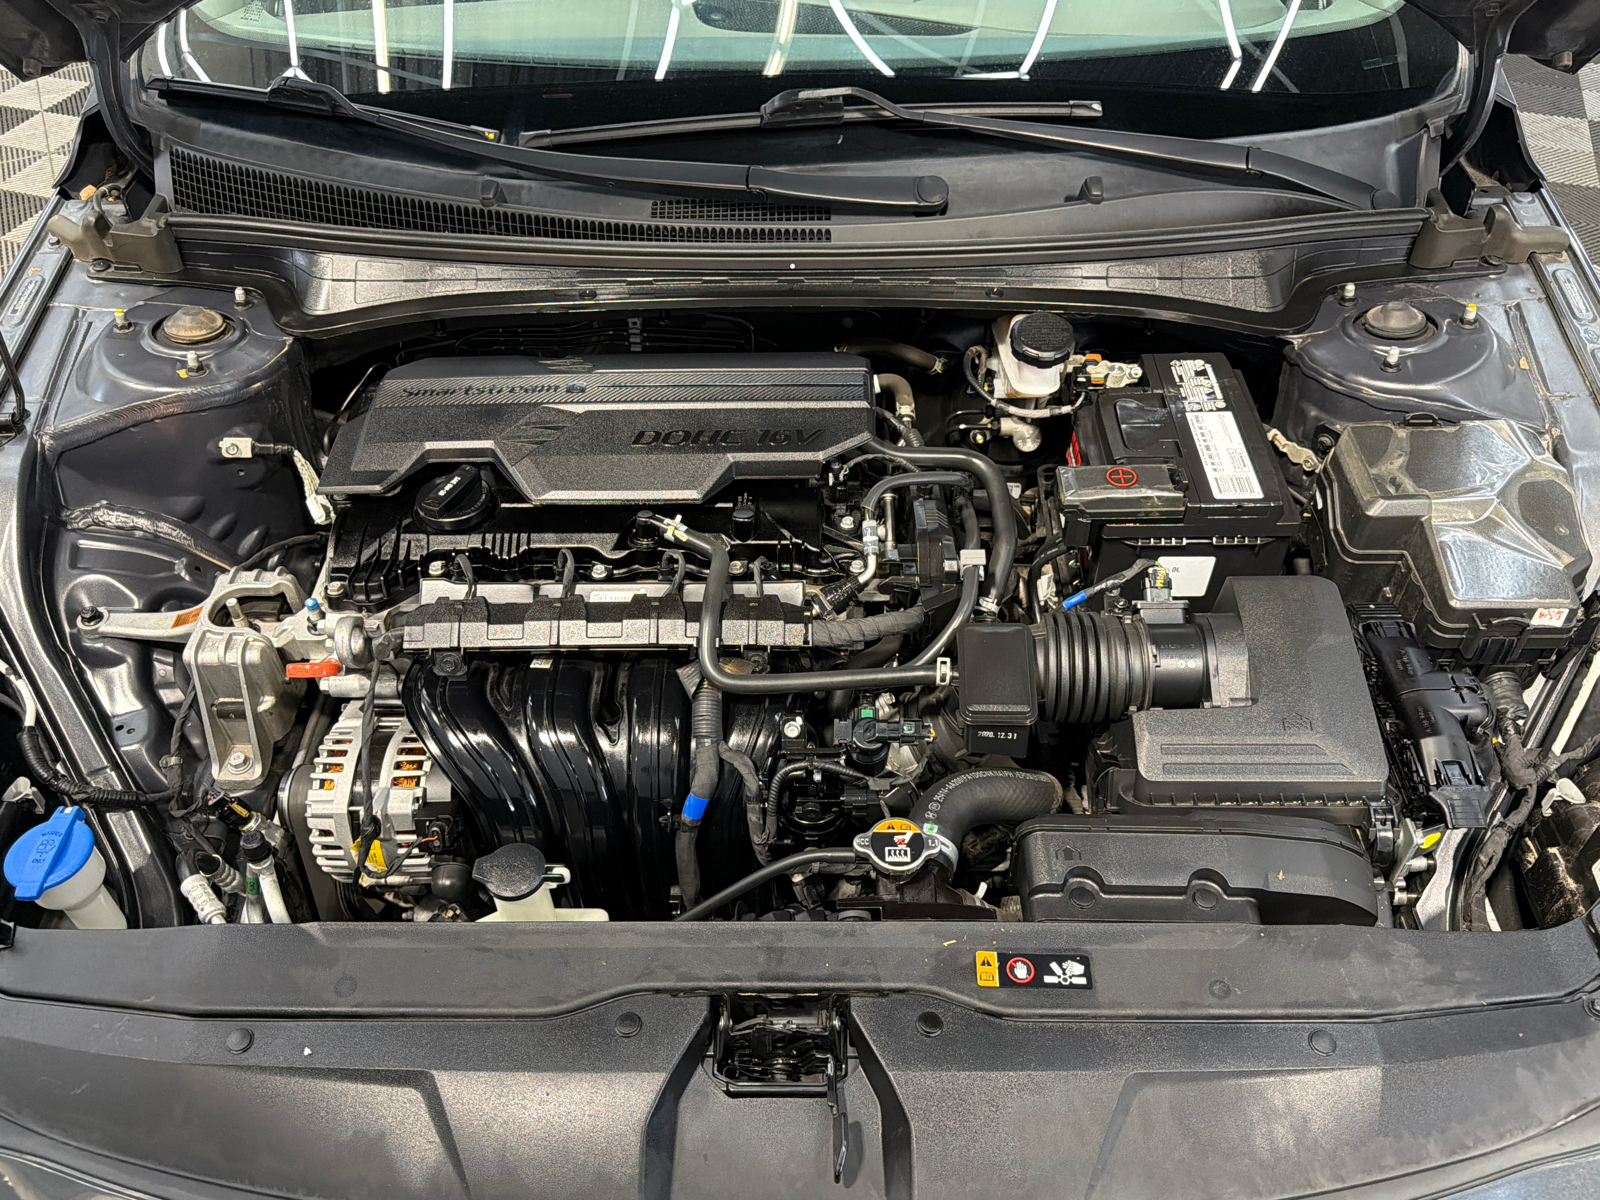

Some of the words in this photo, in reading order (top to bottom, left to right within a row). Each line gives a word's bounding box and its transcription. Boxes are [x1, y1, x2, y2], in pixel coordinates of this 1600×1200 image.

[402, 383, 561, 398] Smartstream
[630, 428, 746, 447] DOHC
[756, 428, 823, 446] 16V
